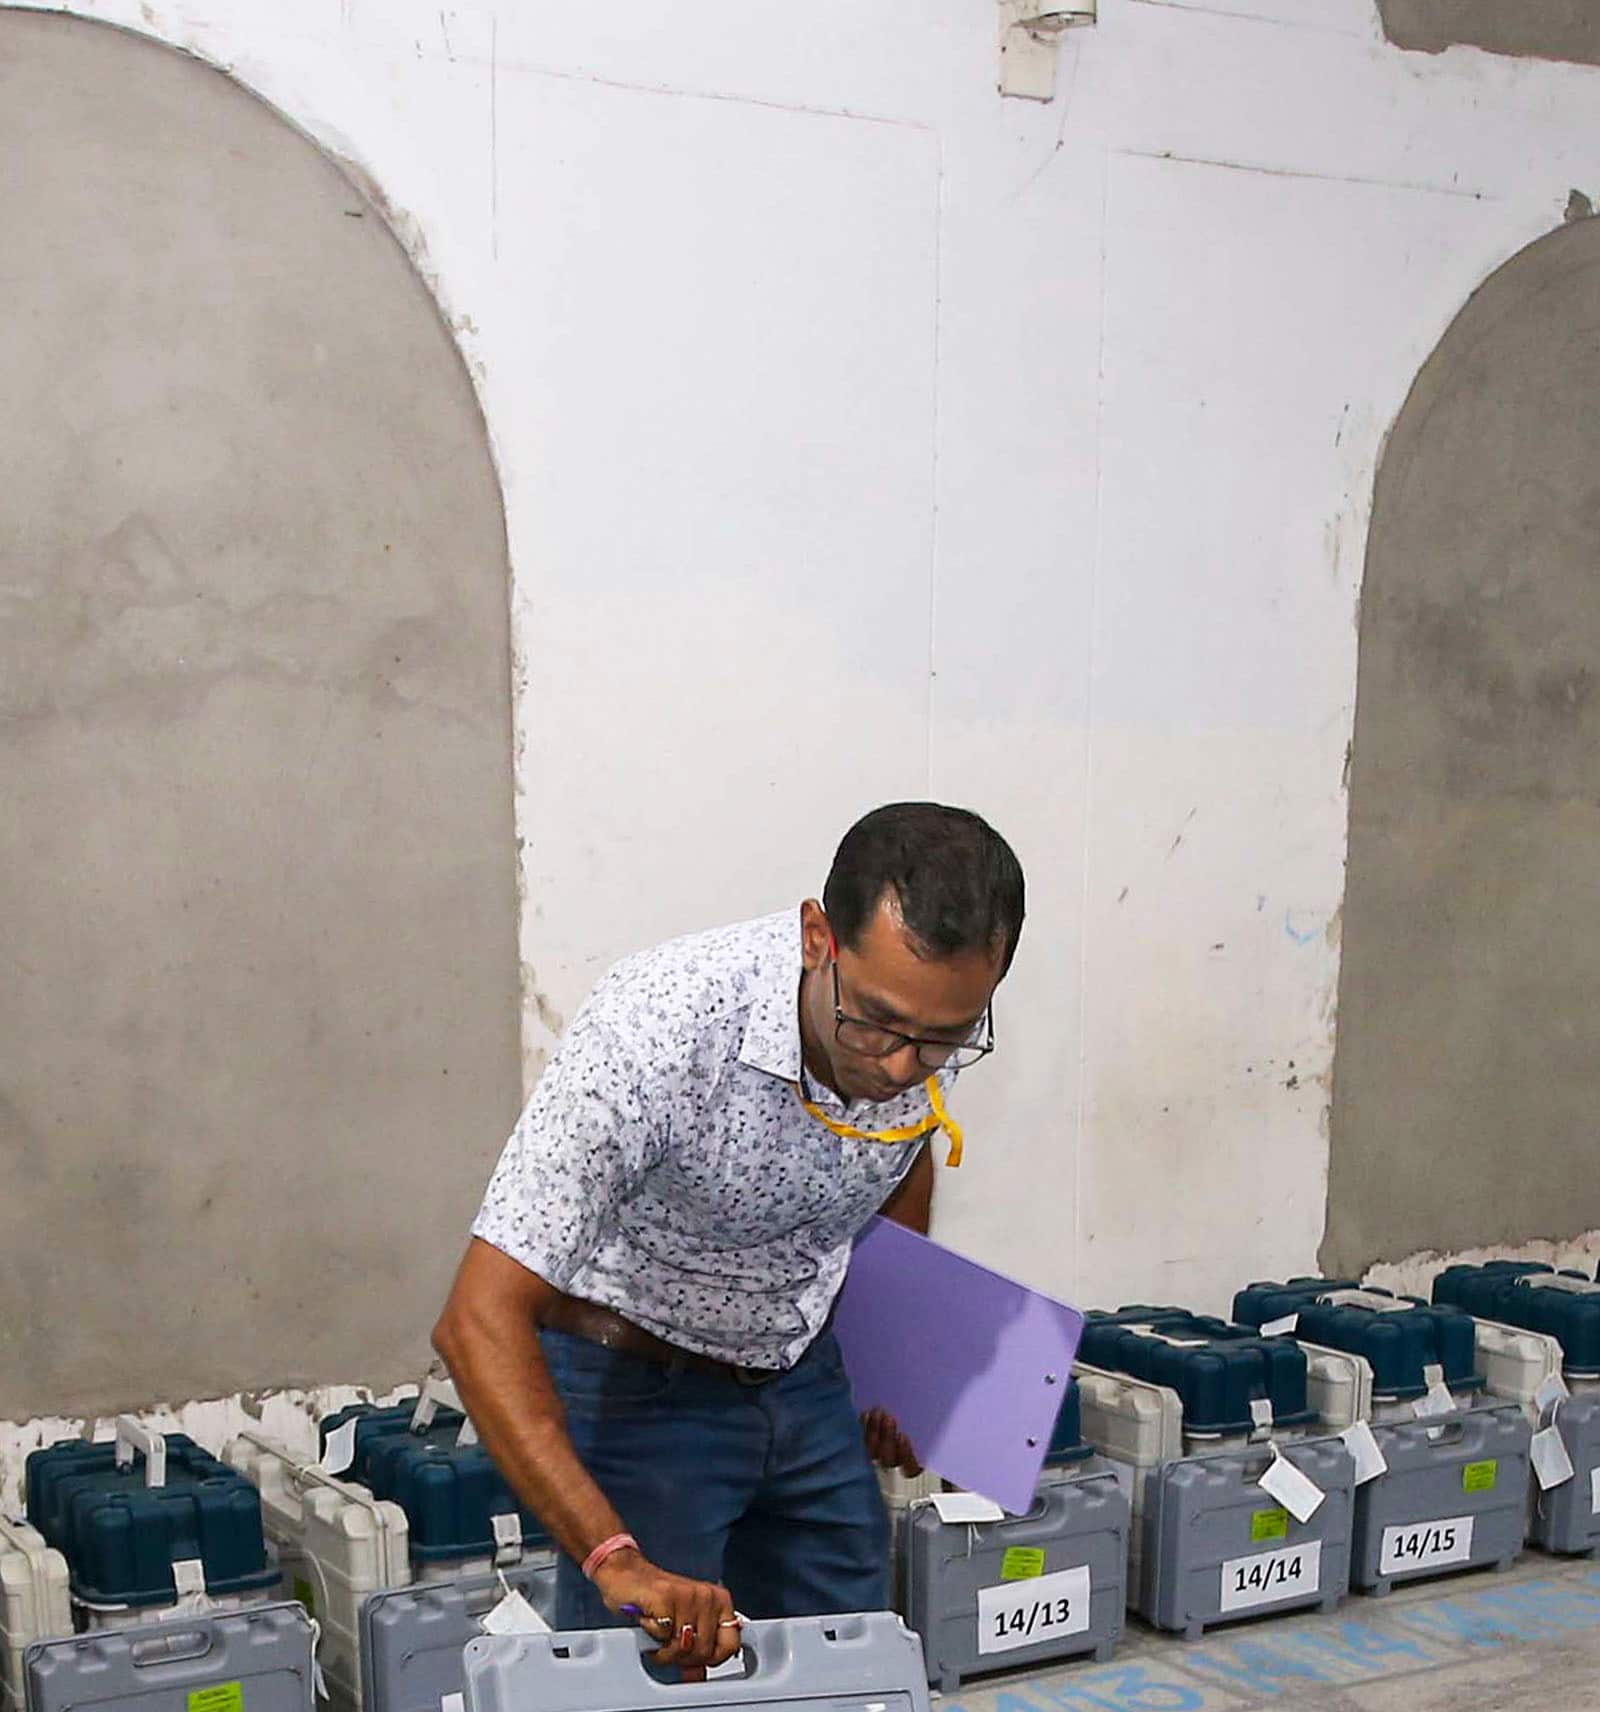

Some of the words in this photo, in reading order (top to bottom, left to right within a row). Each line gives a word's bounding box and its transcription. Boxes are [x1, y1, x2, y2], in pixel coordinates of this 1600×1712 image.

[1392, 1527, 1456, 1559] 14/15
[1233, 1555, 1303, 1592] 14/14
[993, 1597, 1071, 1638] 14/13
